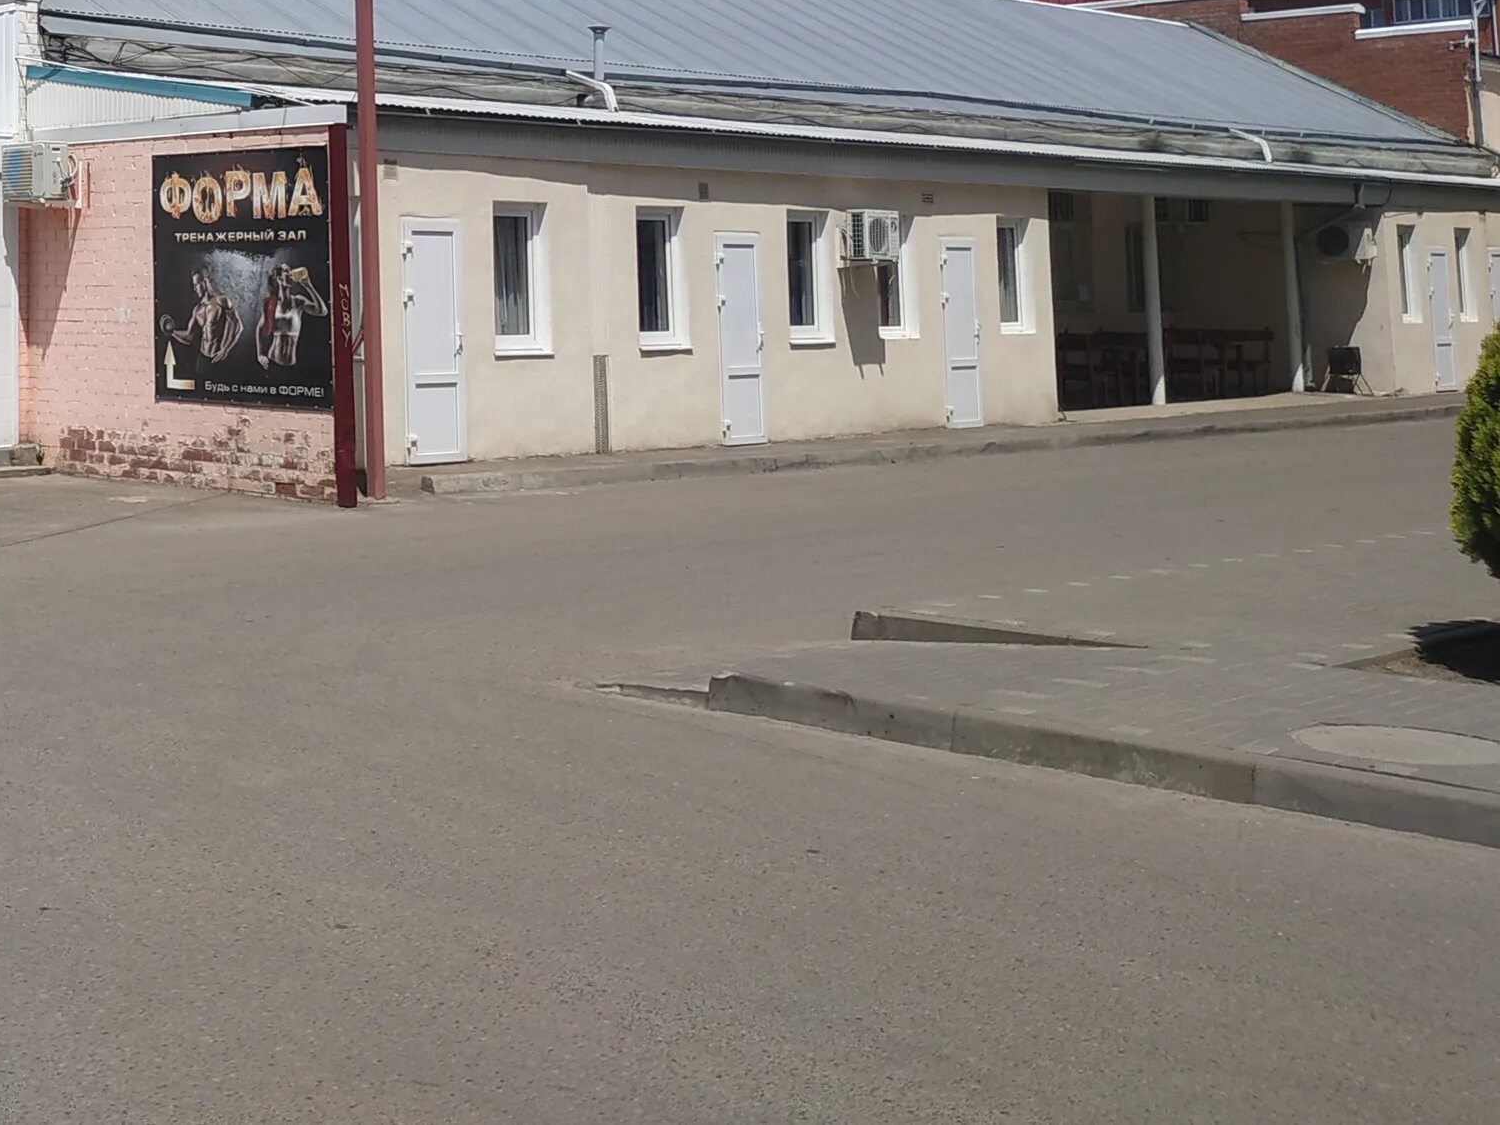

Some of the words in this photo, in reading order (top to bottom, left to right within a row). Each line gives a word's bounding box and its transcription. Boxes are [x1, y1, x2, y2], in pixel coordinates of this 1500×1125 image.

[159, 167, 323, 223] ФОРМА
[174, 228, 274, 243] ТРЕНАЖЕРНЫЙ
[277, 229, 307, 242] ЗАЛ
[204, 380, 230, 393] Будь
[231, 384, 239, 392] с
[240, 385, 268, 394] нами
[269, 386, 277, 394] в
[278, 385, 325, 398] ФОРМЕ!
